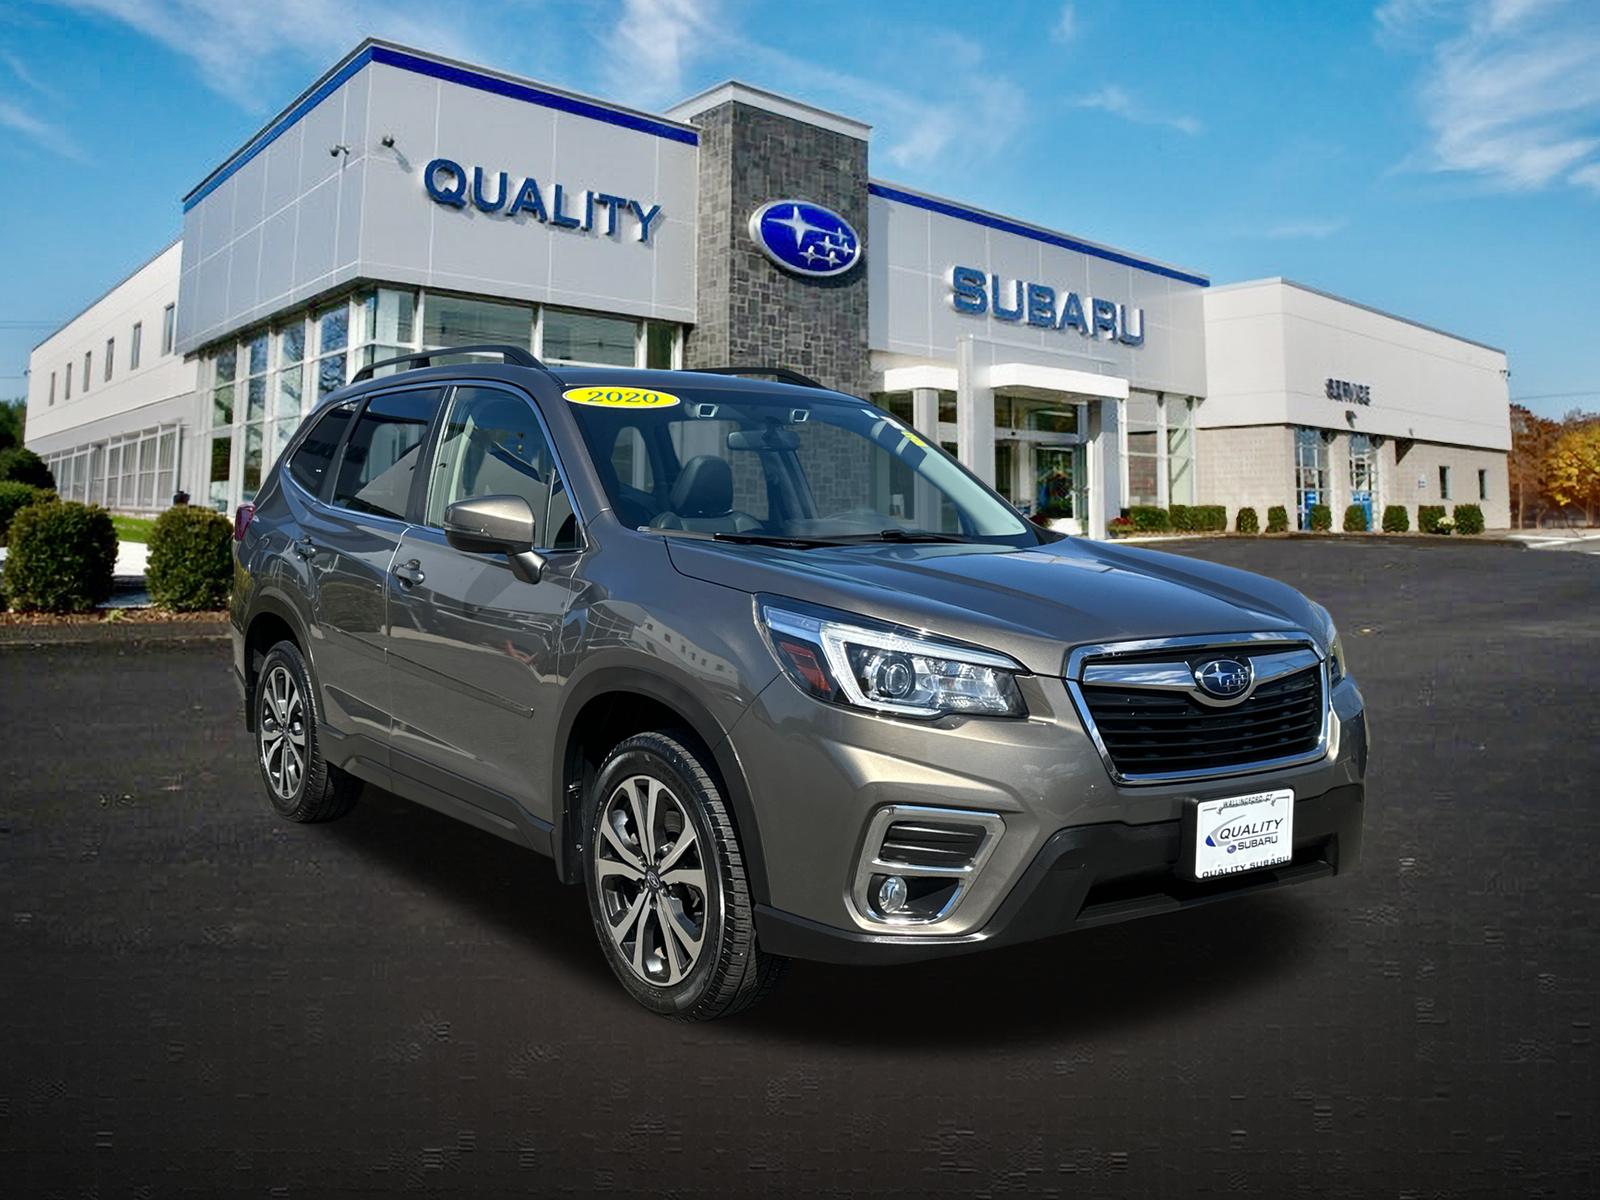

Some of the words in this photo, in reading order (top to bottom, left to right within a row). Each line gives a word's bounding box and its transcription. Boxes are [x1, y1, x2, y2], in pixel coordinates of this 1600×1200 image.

[424, 158, 661, 243] QUALITY
[952, 265, 1145, 347] SUBARU
[587, 391, 659, 404] 2020
[1220, 818, 1283, 839] QUALITY
[1237, 836, 1278, 850] SUBARU
[1202, 864, 1246, 878] QUALITY
[1249, 855, 1289, 869] SUBARU
